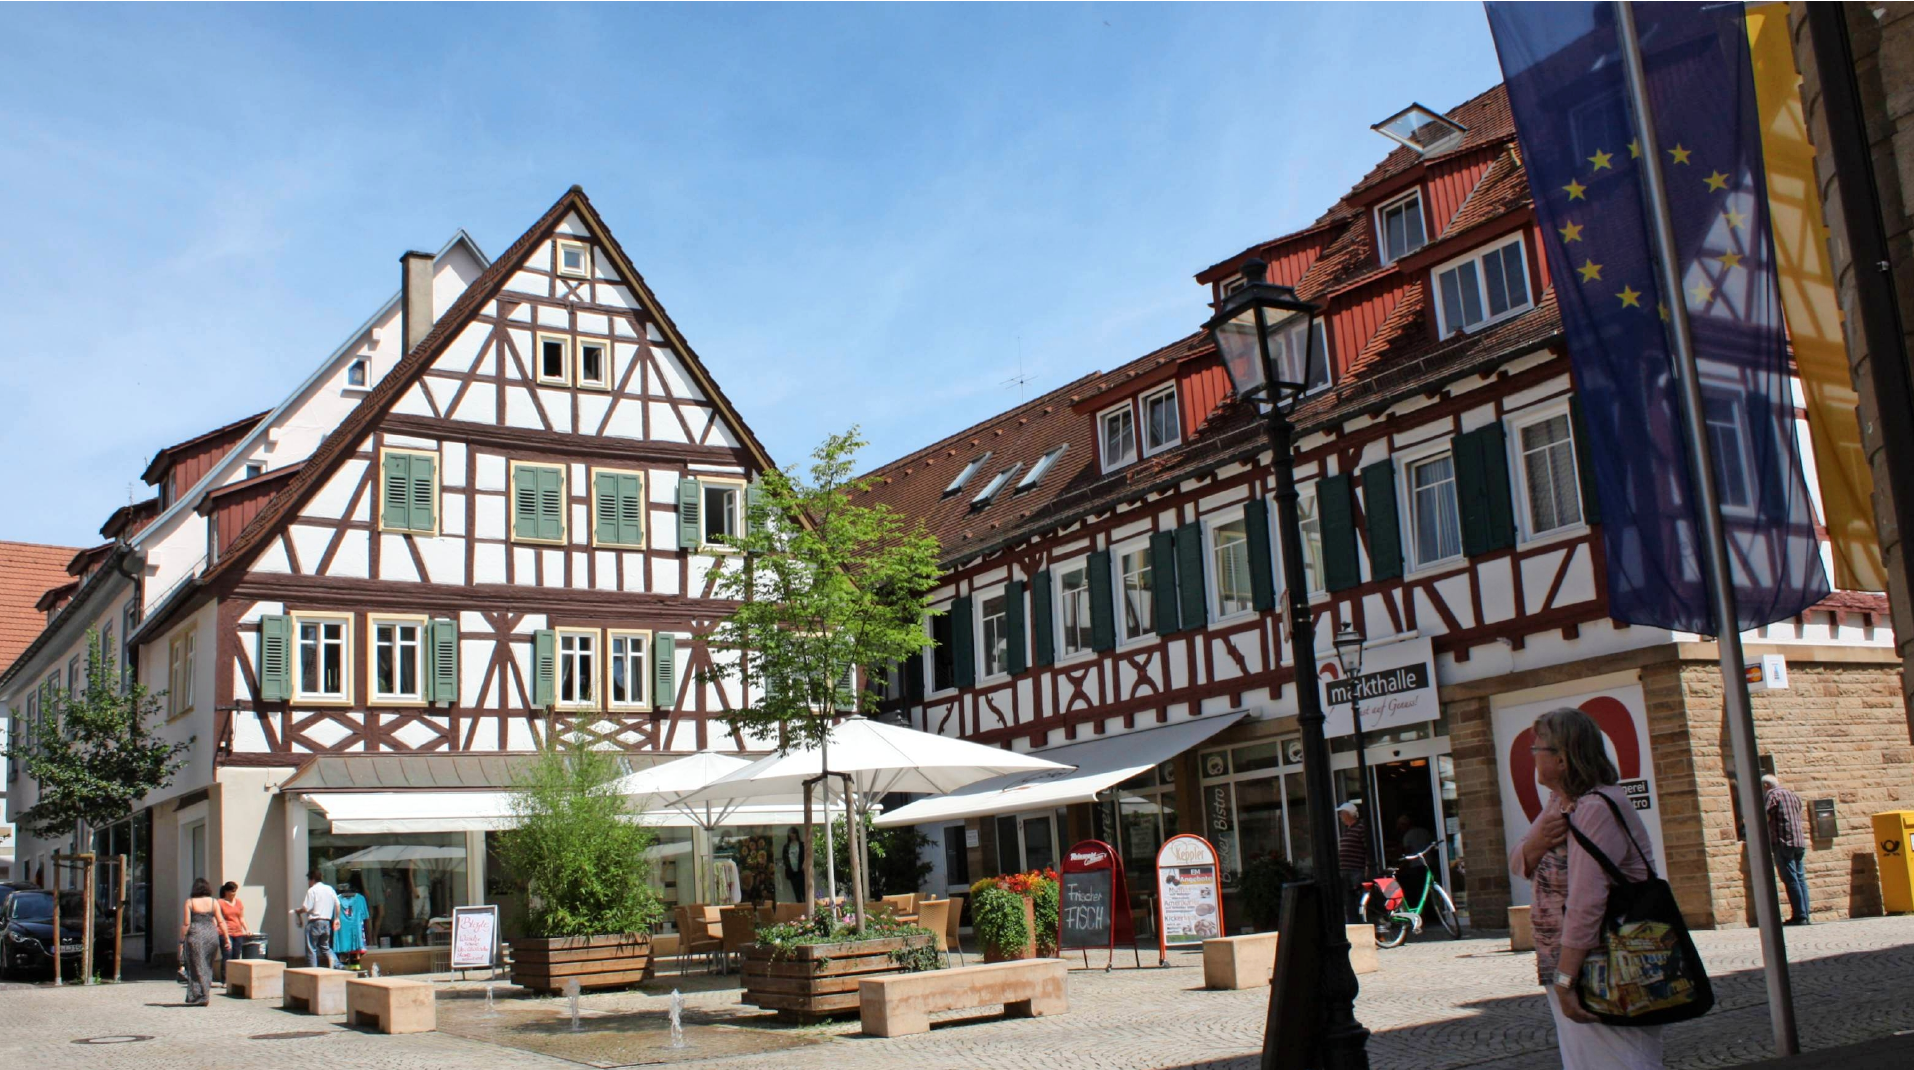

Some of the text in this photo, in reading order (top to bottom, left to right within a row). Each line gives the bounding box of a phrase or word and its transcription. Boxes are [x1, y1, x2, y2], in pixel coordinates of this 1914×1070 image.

[1388, 695, 1419, 716] Genuss!
[1213, 787, 1228, 831] Bistro
[1175, 846, 1205, 865] Keppler
[1067, 883, 1103, 902] Frischer
[1064, 906, 1104, 930] FISCH
